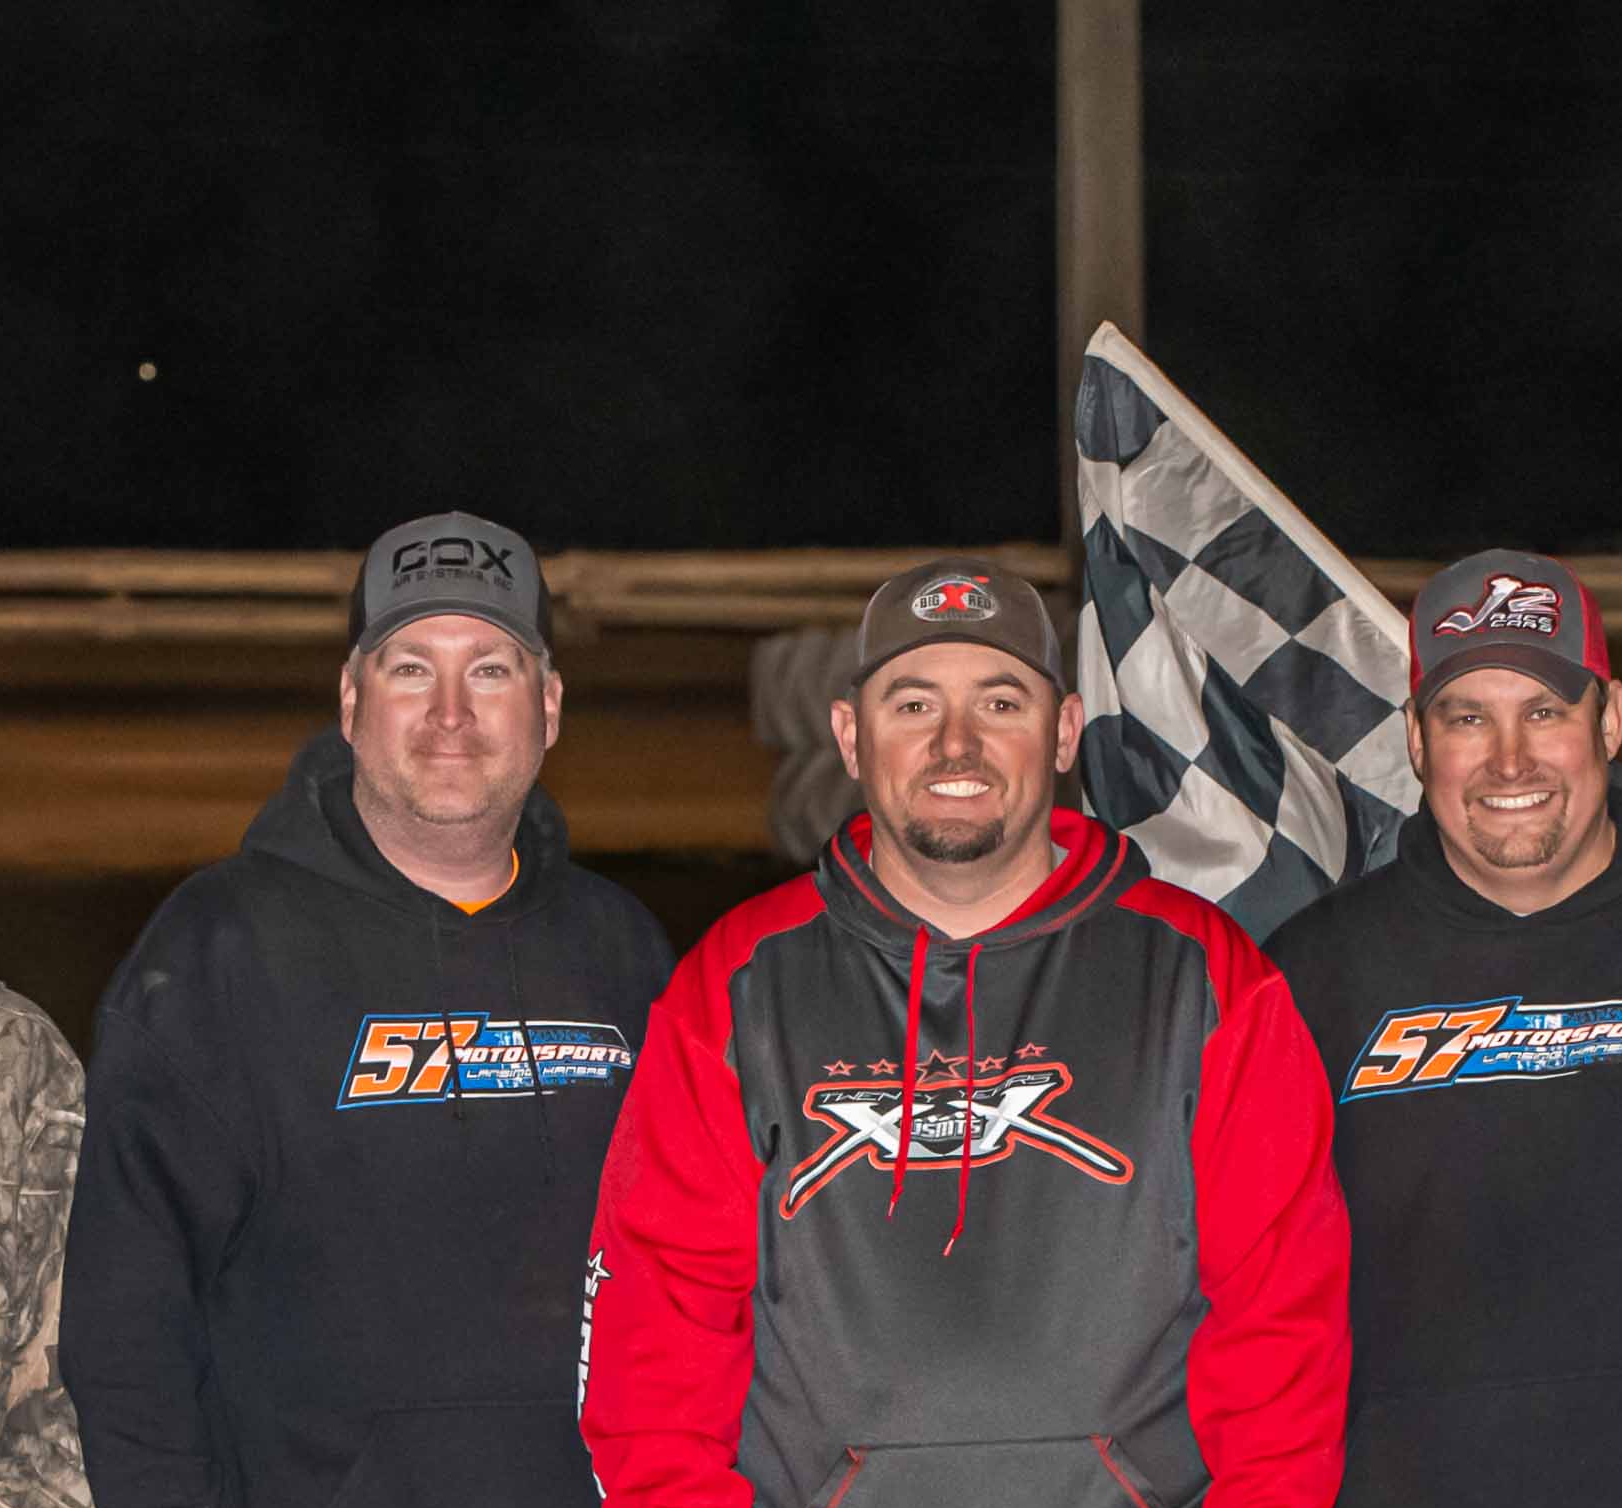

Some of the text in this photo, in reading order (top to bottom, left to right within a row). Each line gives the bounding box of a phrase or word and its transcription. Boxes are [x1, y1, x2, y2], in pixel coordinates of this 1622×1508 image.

[392, 537, 515, 579] COX
[919, 595, 941, 609] BIG
[967, 594, 993, 609] RED
[347, 1020, 480, 1098] 57
[454, 1044, 633, 1066] MOTORSPORTS
[1347, 1004, 1509, 1091] 57
[823, 1090, 939, 1103] TWENY
